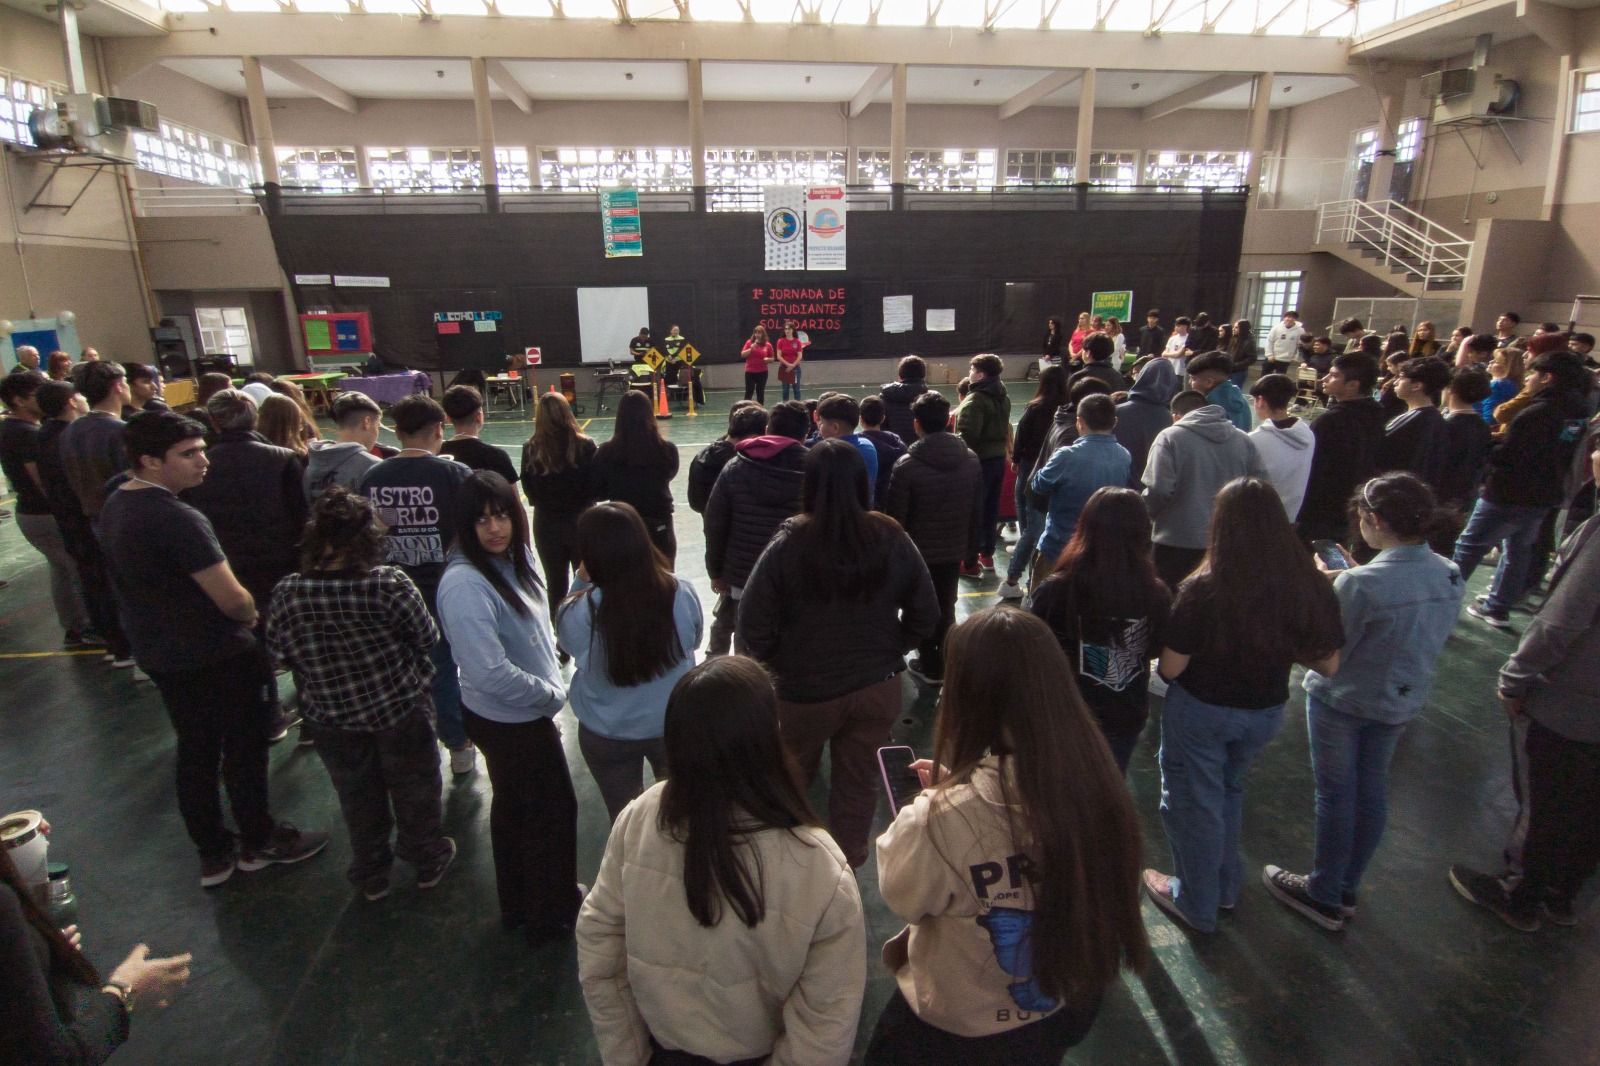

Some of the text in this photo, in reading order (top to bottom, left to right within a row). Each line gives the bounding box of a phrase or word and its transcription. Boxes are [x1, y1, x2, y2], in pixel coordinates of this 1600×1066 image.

[769, 287, 824, 300] JORNADA
[829, 287, 846, 300] DE
[760, 303, 846, 315] ESTUDIANTES
[369, 486, 434, 507] ASTRO
